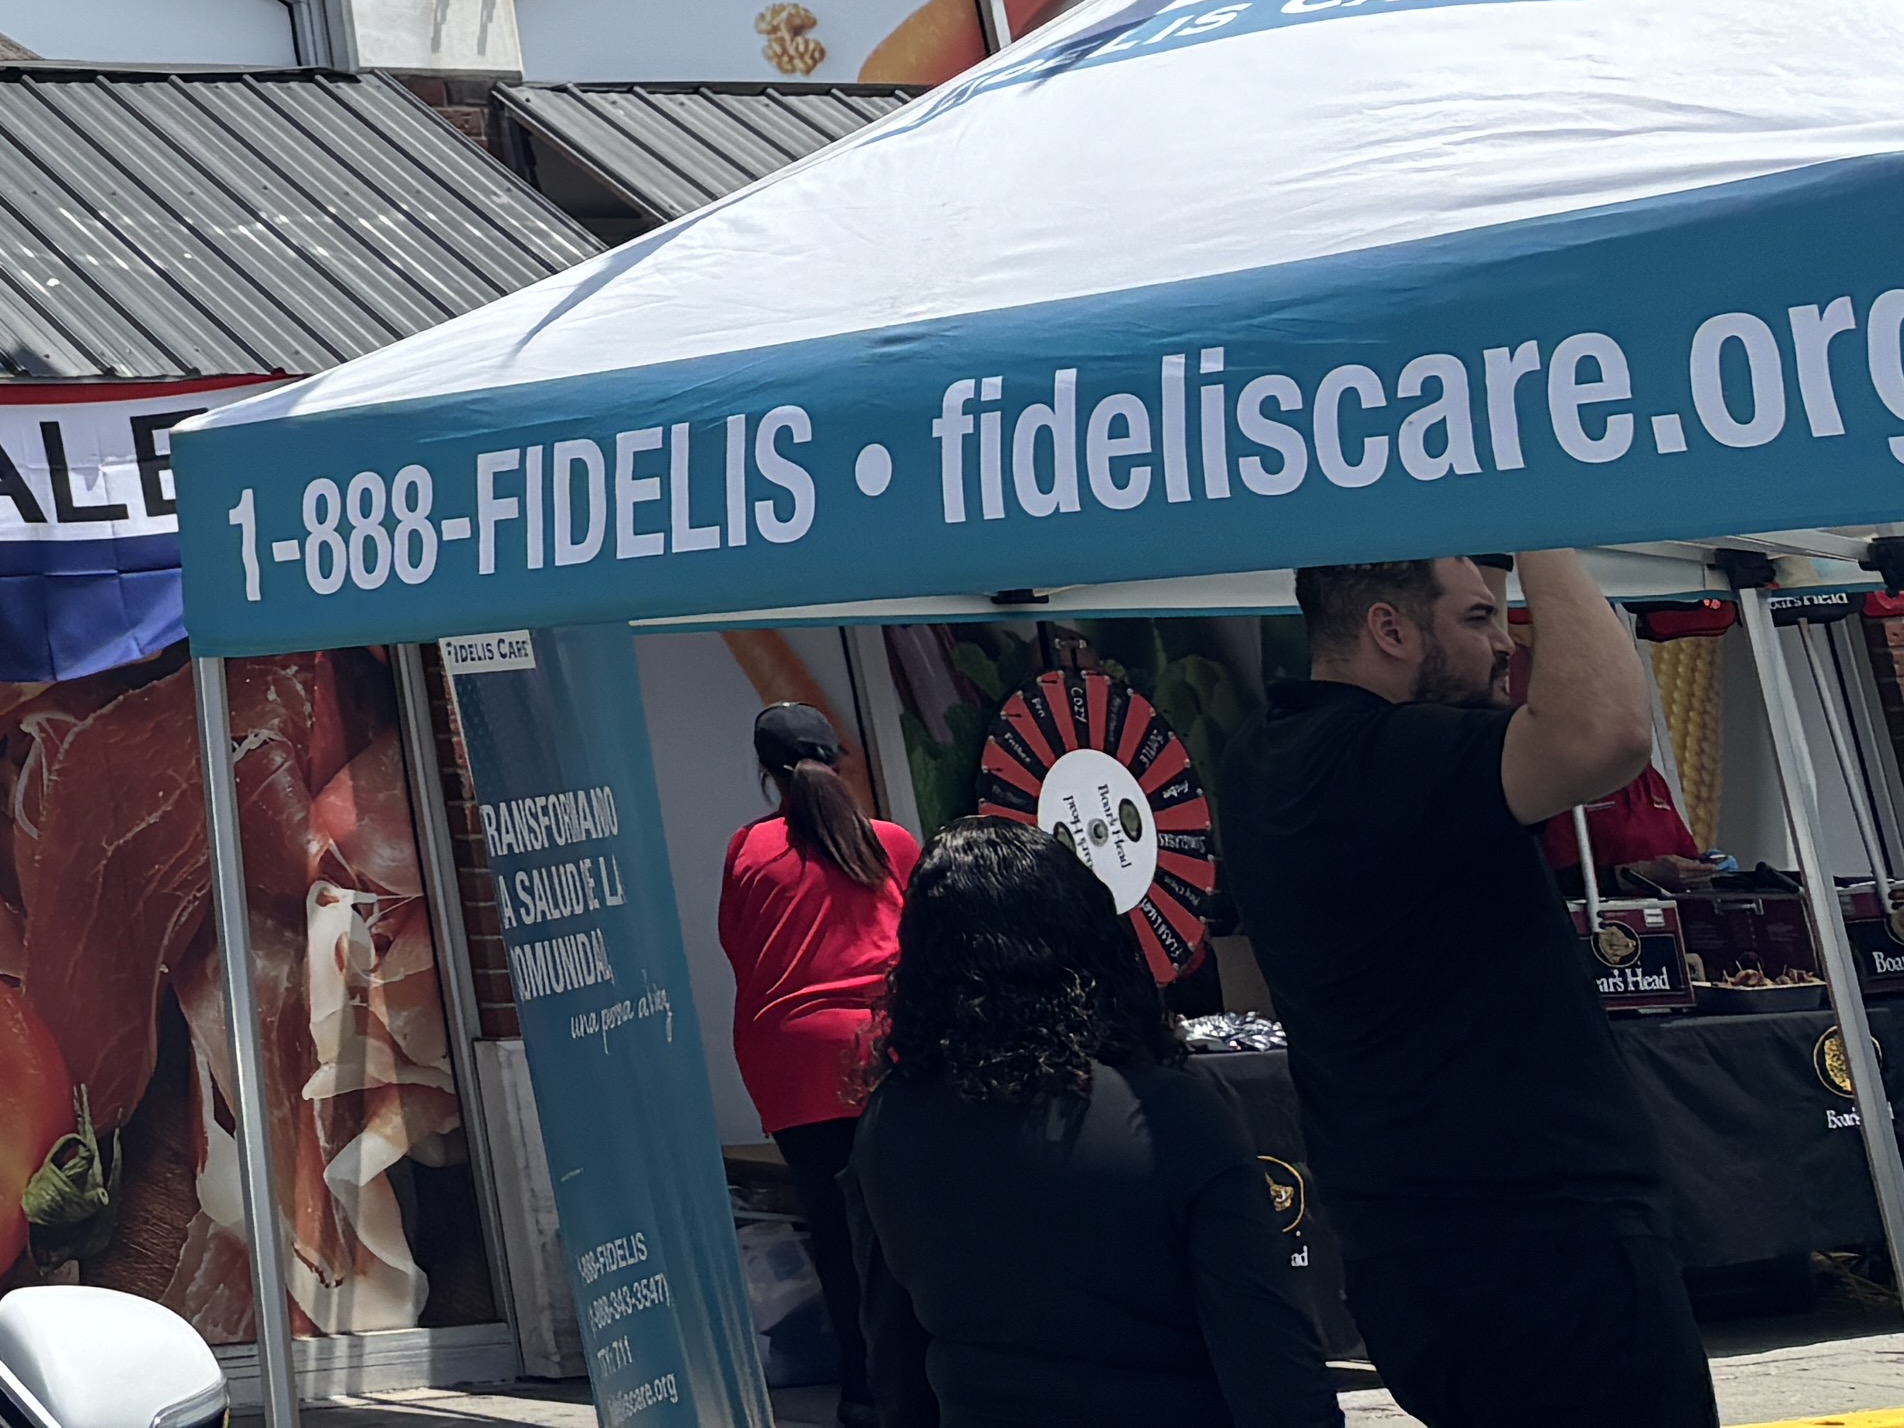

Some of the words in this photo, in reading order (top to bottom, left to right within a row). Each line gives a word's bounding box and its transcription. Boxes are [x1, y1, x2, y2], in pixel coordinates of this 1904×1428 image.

[227, 404, 817, 603] 1-888-FIDELIS
[1596, 968, 1625, 993] ar's
[1625, 965, 1671, 992] Head
